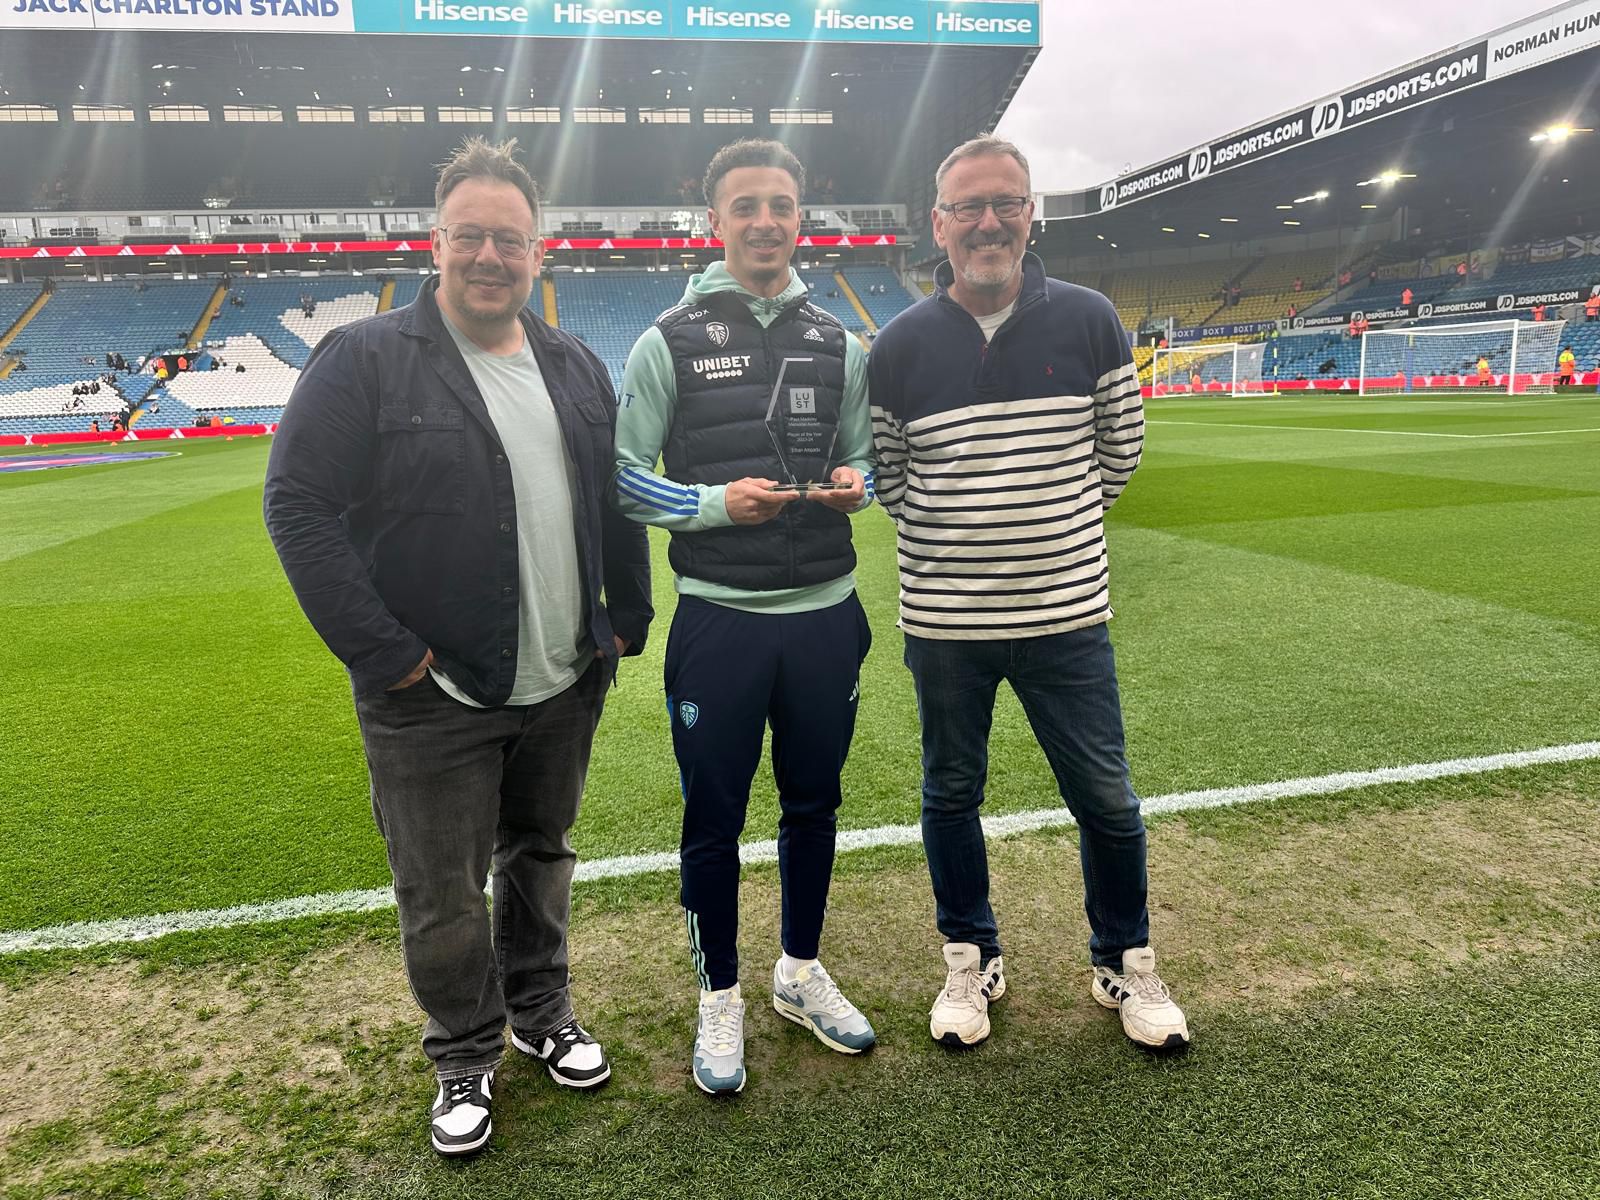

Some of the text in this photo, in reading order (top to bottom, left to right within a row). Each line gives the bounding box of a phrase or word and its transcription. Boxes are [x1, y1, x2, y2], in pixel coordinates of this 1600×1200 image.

[12, 0, 339, 18] JACK CHARLTON STAND
[414, 0, 529, 23] Hisense
[553, 3, 663, 26] Hisense
[686, 6, 791, 28] Hisense
[813, 9, 914, 31] Hisense
[936, 12, 1032, 33] Hisense
[1493, 27, 1560, 63] NORMAN
[1315, 54, 1479, 131] JD JDSPORTS.COM
[1192, 119, 1303, 176] JD JDSPORTS.COM
[1102, 164, 1183, 208] JD JDSPORTS.COM
[1434, 301, 1487, 313] JDSPORTS.COM
[1500, 291, 1579, 310] JD JDSPORTS.COM
[803, 334, 824, 342] adidas
[1202, 327, 1225, 336] BOXT
[1233, 324, 1254, 334] BOXT
[693, 355, 750, 373] UNIBET
[795, 392, 810, 400] LU
[795, 401, 810, 409] ST
